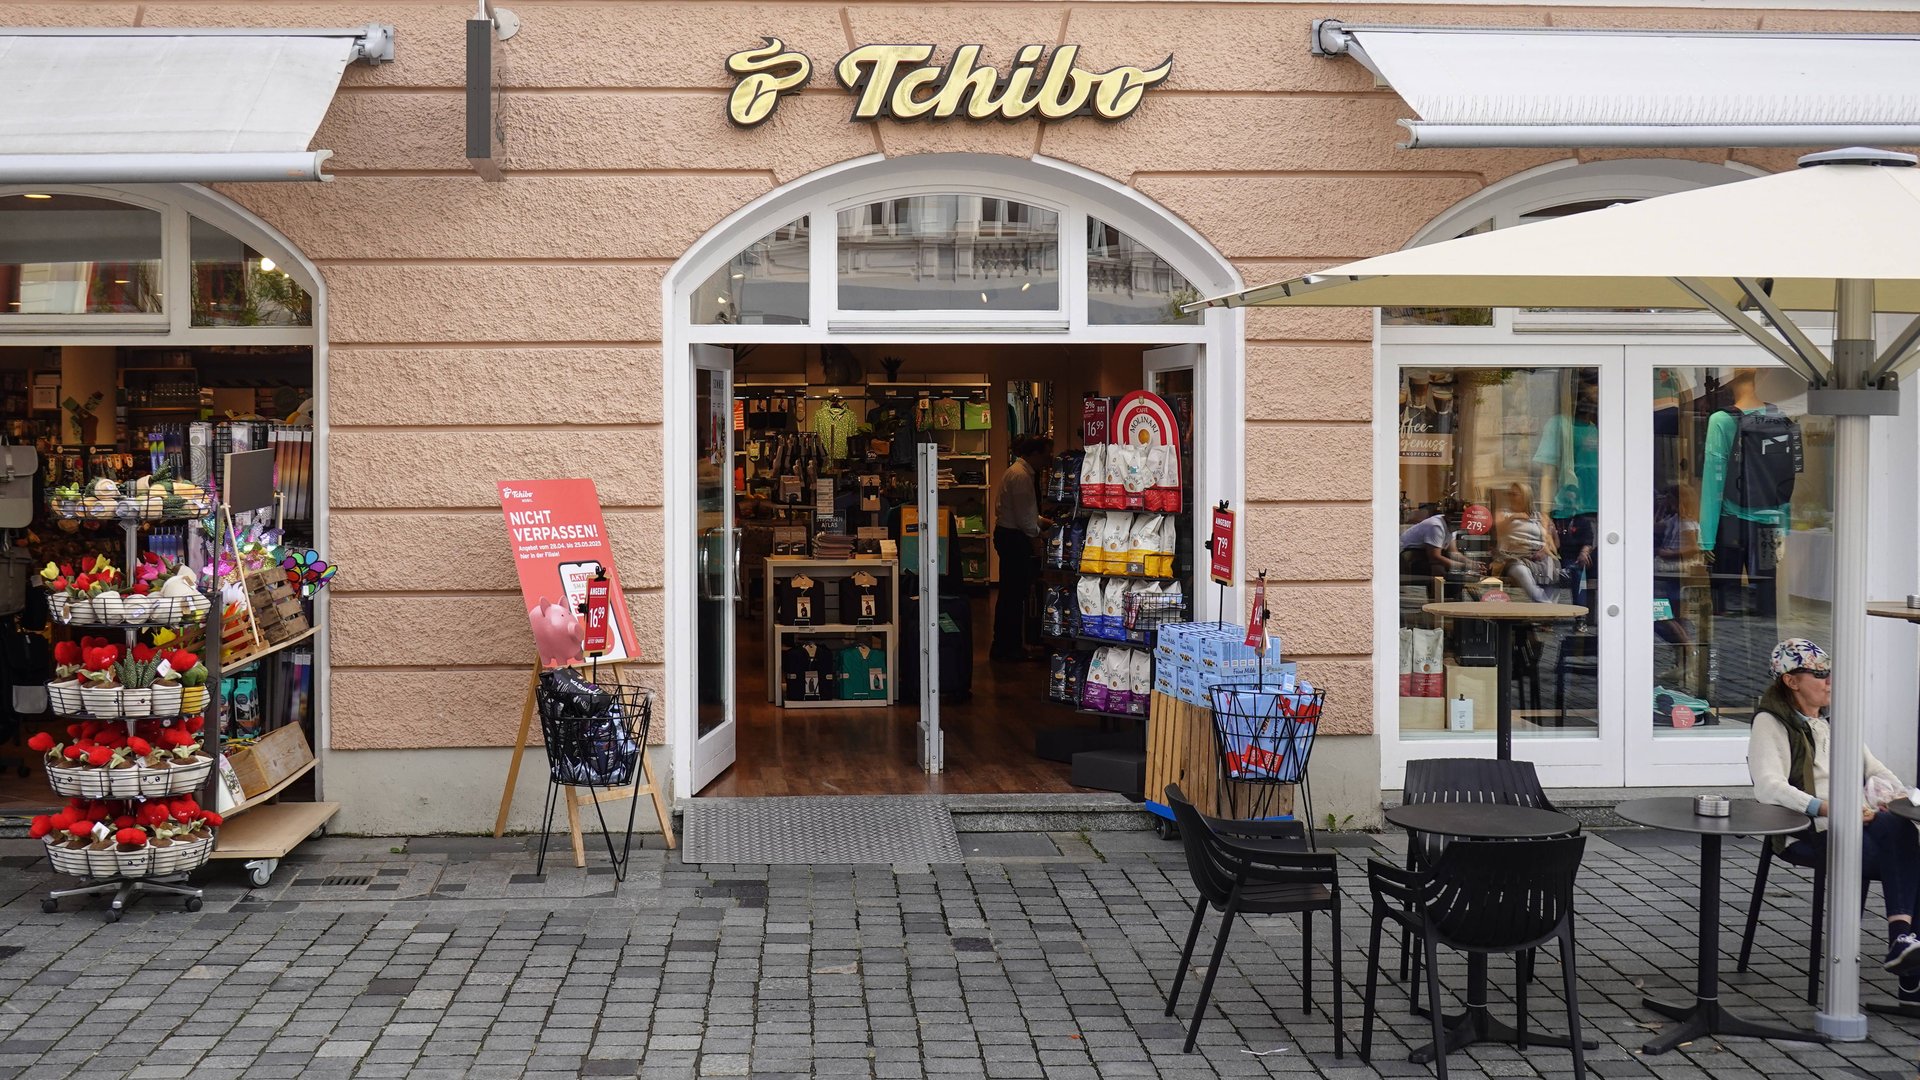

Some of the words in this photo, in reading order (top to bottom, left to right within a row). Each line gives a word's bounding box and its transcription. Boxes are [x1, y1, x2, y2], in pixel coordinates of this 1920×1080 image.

[836, 44, 1173, 121] Tchibo
[1130, 416, 1158, 433] MOLINARI
[511, 489, 534, 498] Tchibo
[509, 510, 551, 525] NICHT
[1215, 517, 1231, 529] ANGEBOT
[513, 524, 599, 542] VERPASSEN!
[590, 587, 607, 595] ANGEBOT
